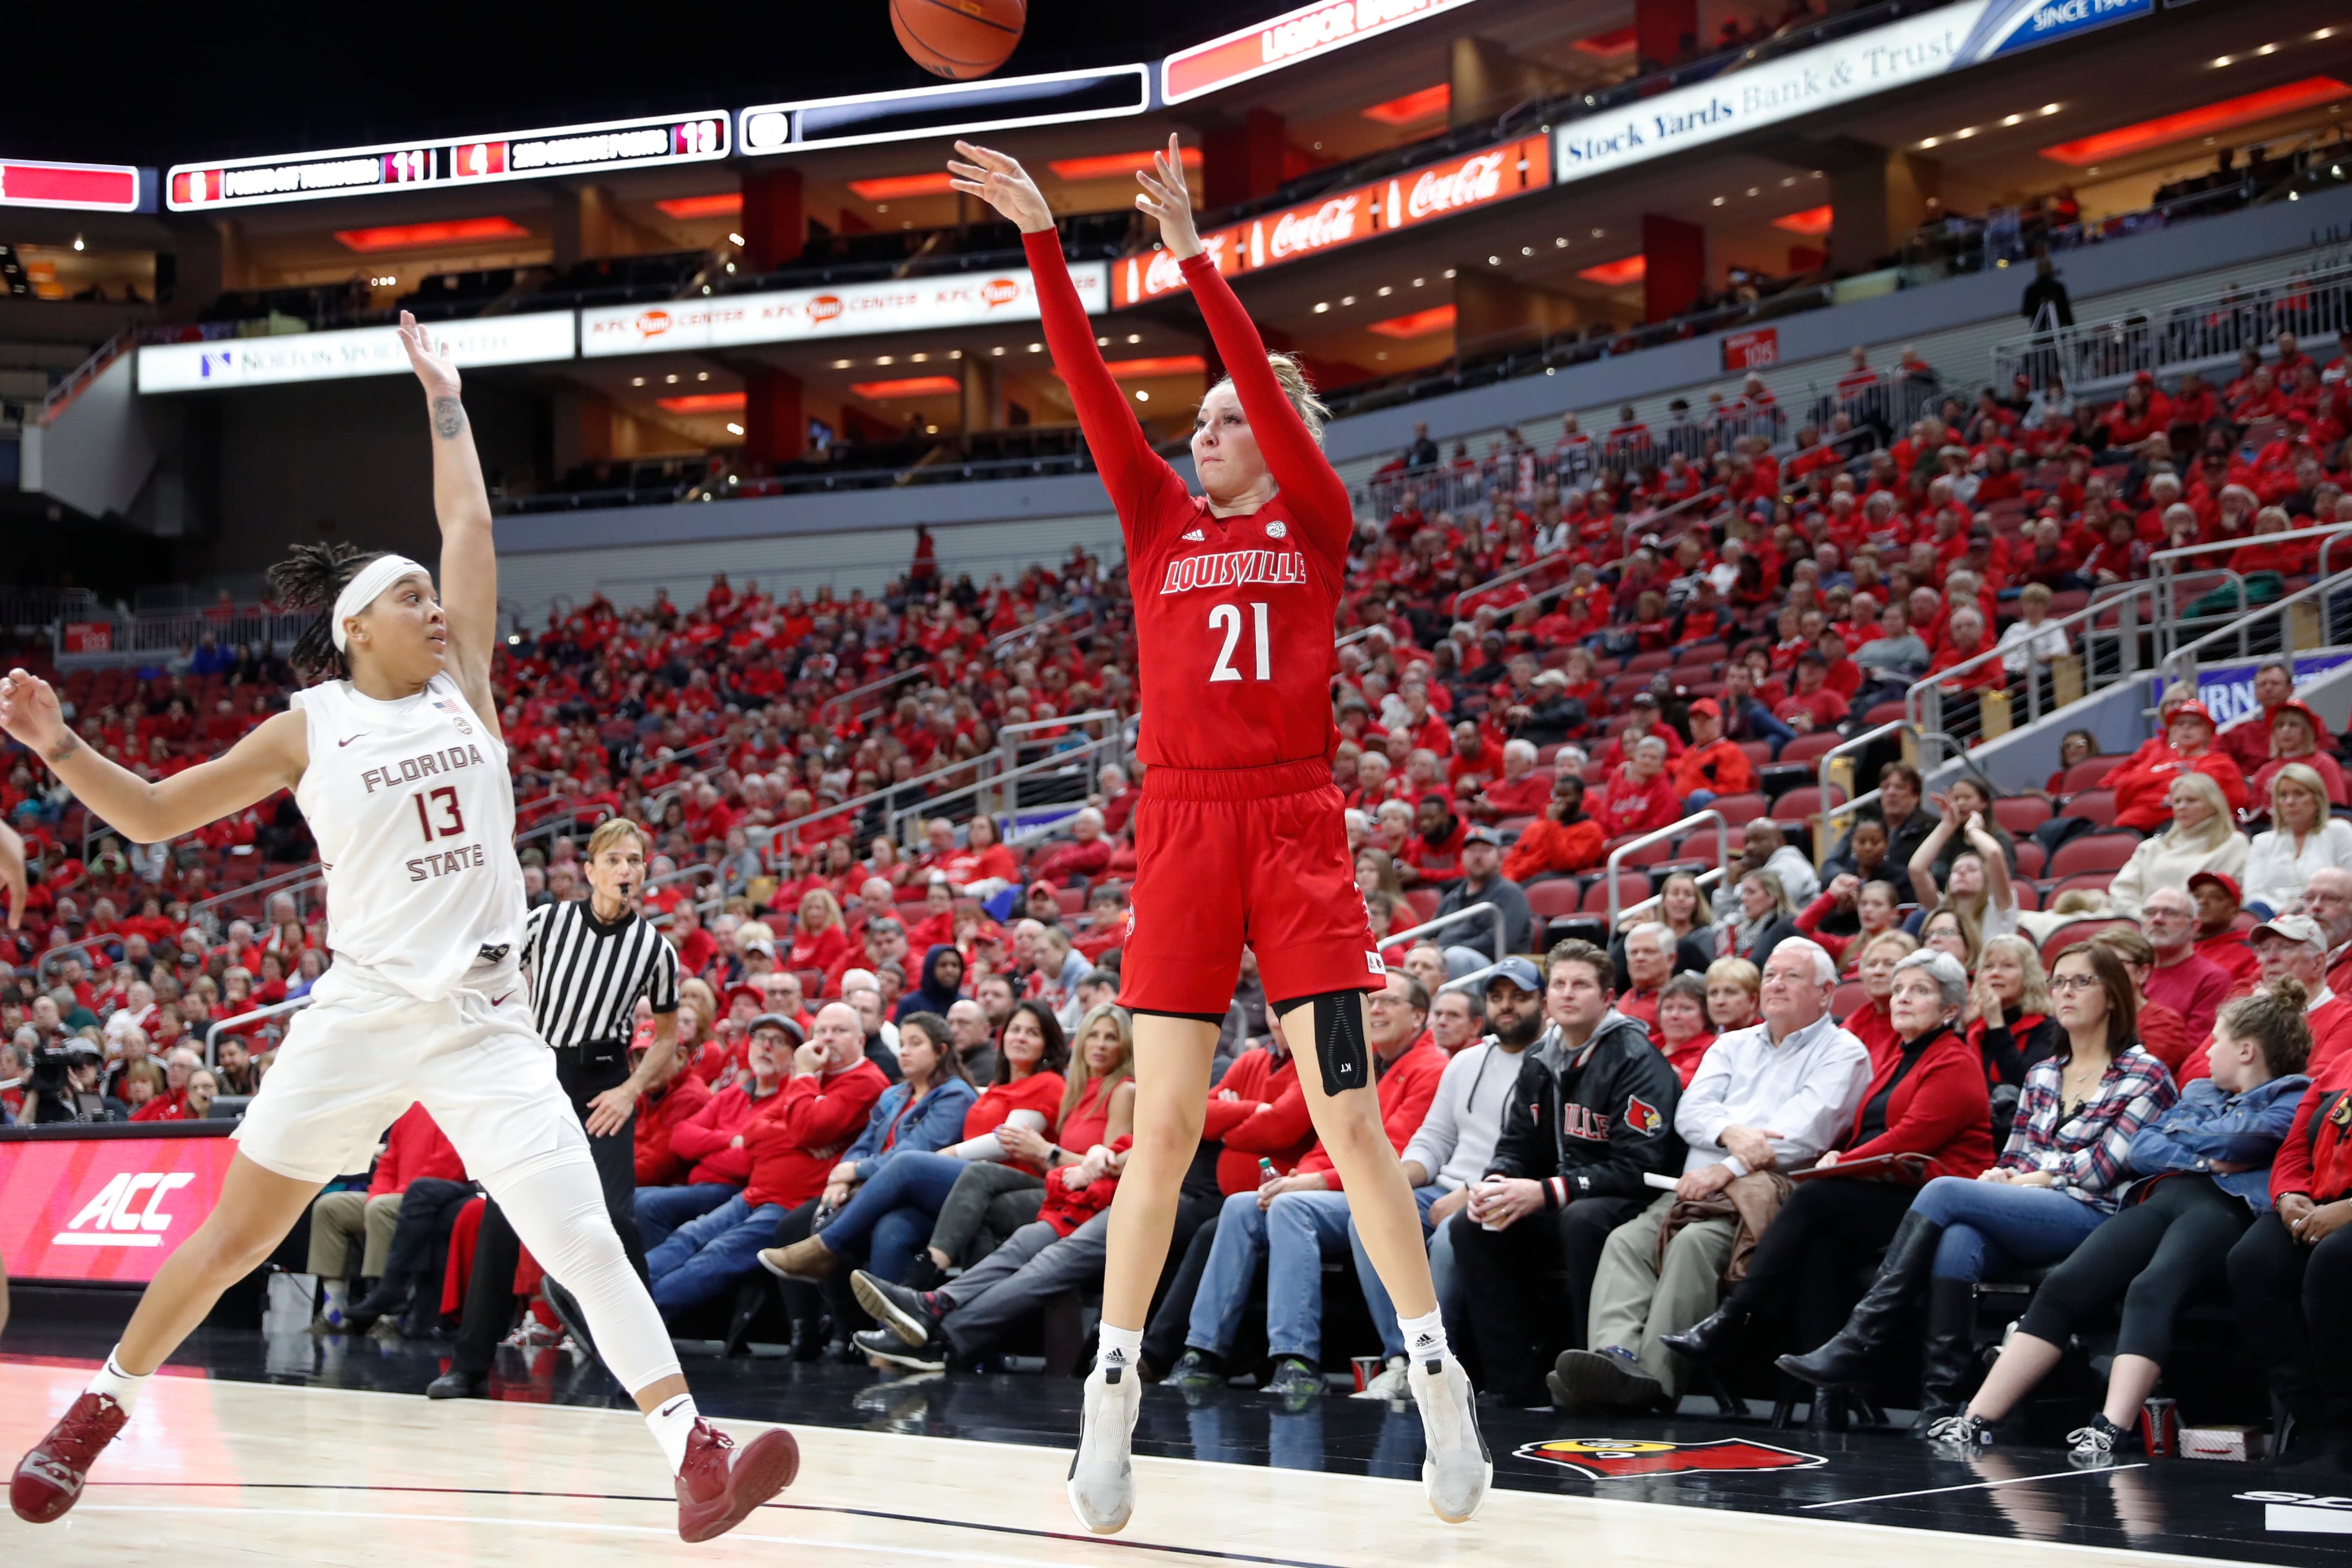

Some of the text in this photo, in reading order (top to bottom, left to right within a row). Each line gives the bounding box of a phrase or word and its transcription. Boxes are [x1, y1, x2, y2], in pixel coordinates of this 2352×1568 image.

[2033, 1, 2090, 32] SINCE
[1567, 29, 1957, 165] Stock Yards Bank & Trust
[392, 150, 425, 183] 11
[762, 306, 796, 318] KFC
[849, 293, 917, 311] CENTER
[936, 288, 973, 303] KFC
[593, 320, 627, 333] KFC
[678, 309, 745, 326] CENTER
[340, 342, 404, 363] SPORT
[1159, 550, 1306, 594] LOUISVILLE
[1209, 602, 1271, 682] 21
[362, 744, 485, 793] FLORIDA
[412, 785, 466, 843] 13
[406, 844, 485, 882] STATE
[1340, 1063, 1352, 1073] KT
[67, 1172, 196, 1231] ACC
